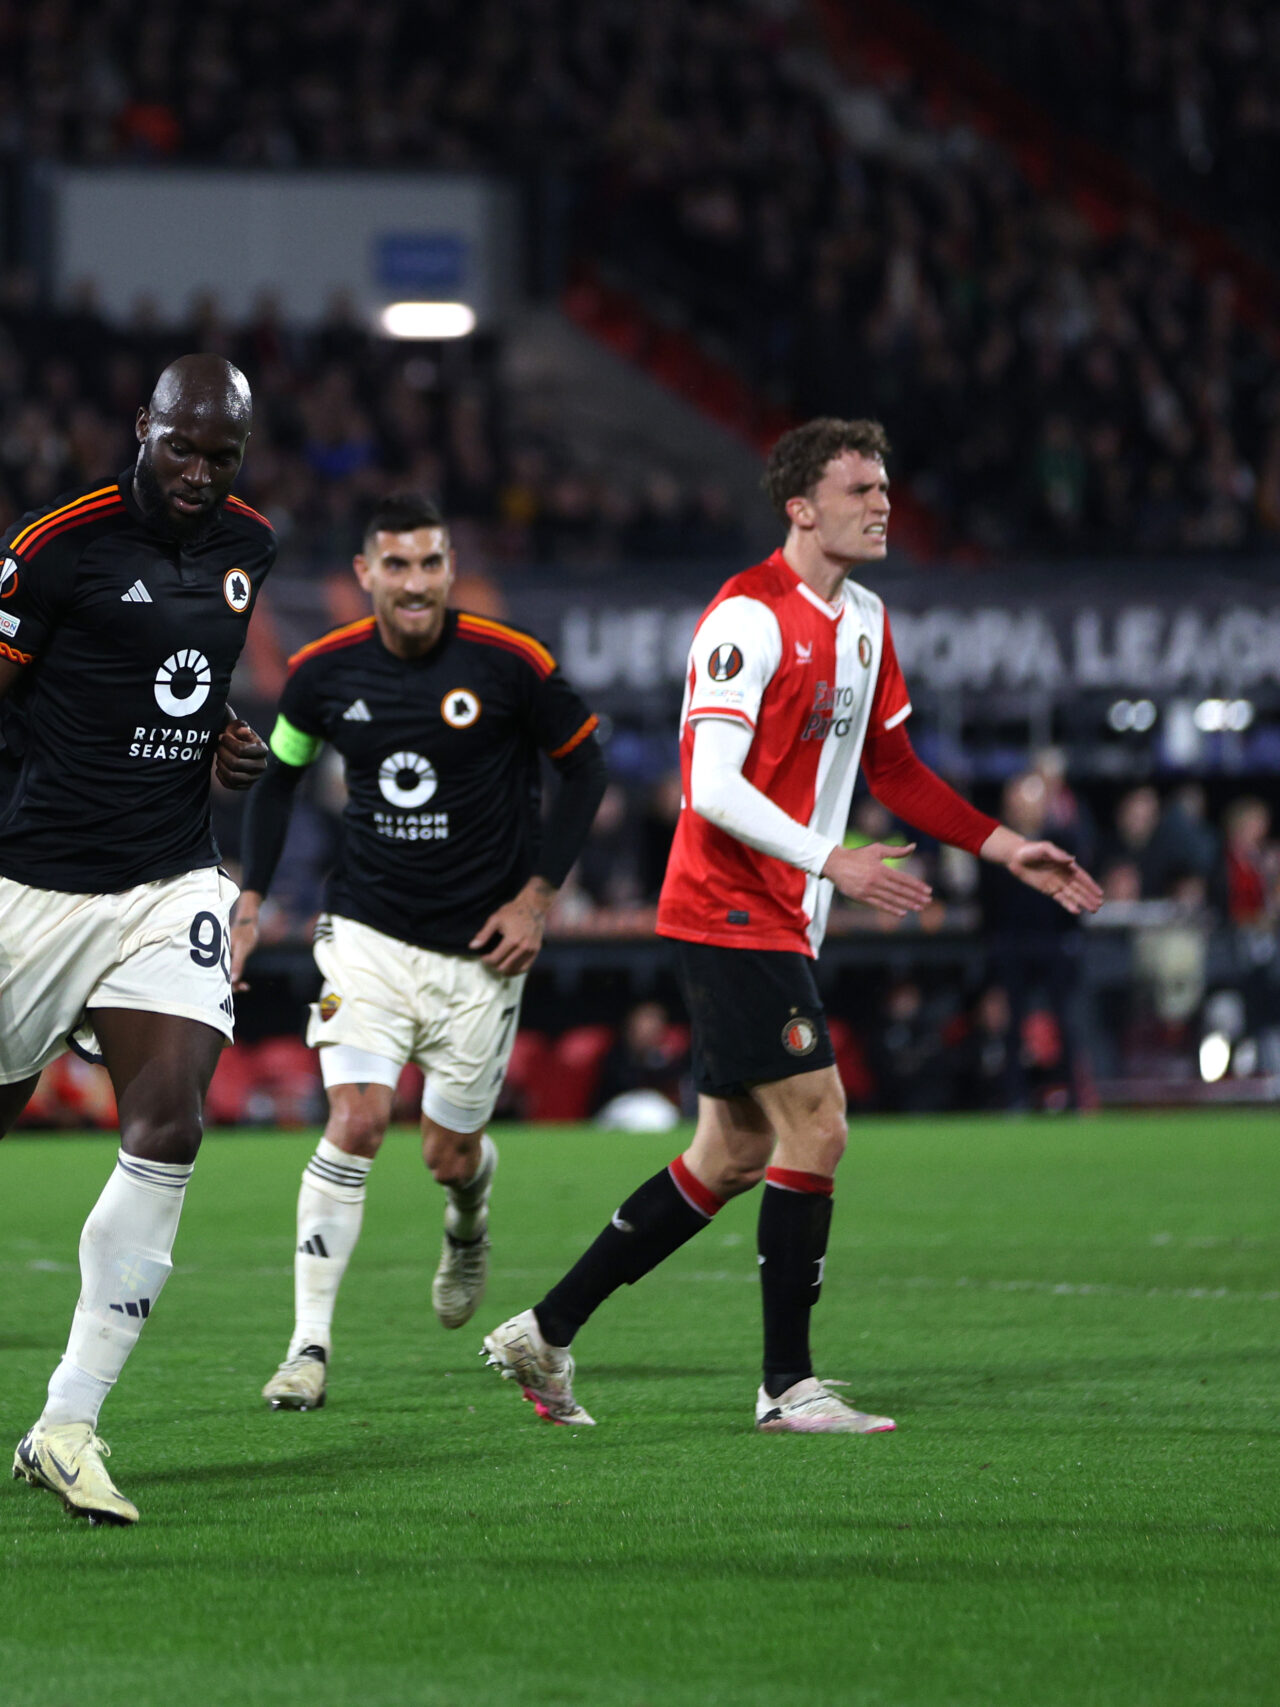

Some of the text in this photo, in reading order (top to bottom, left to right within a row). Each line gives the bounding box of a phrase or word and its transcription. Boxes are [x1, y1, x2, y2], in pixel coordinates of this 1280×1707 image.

[133, 726, 211, 744] RIYADH
[128, 743, 204, 761] SEASON
[189, 910, 222, 968] 9
